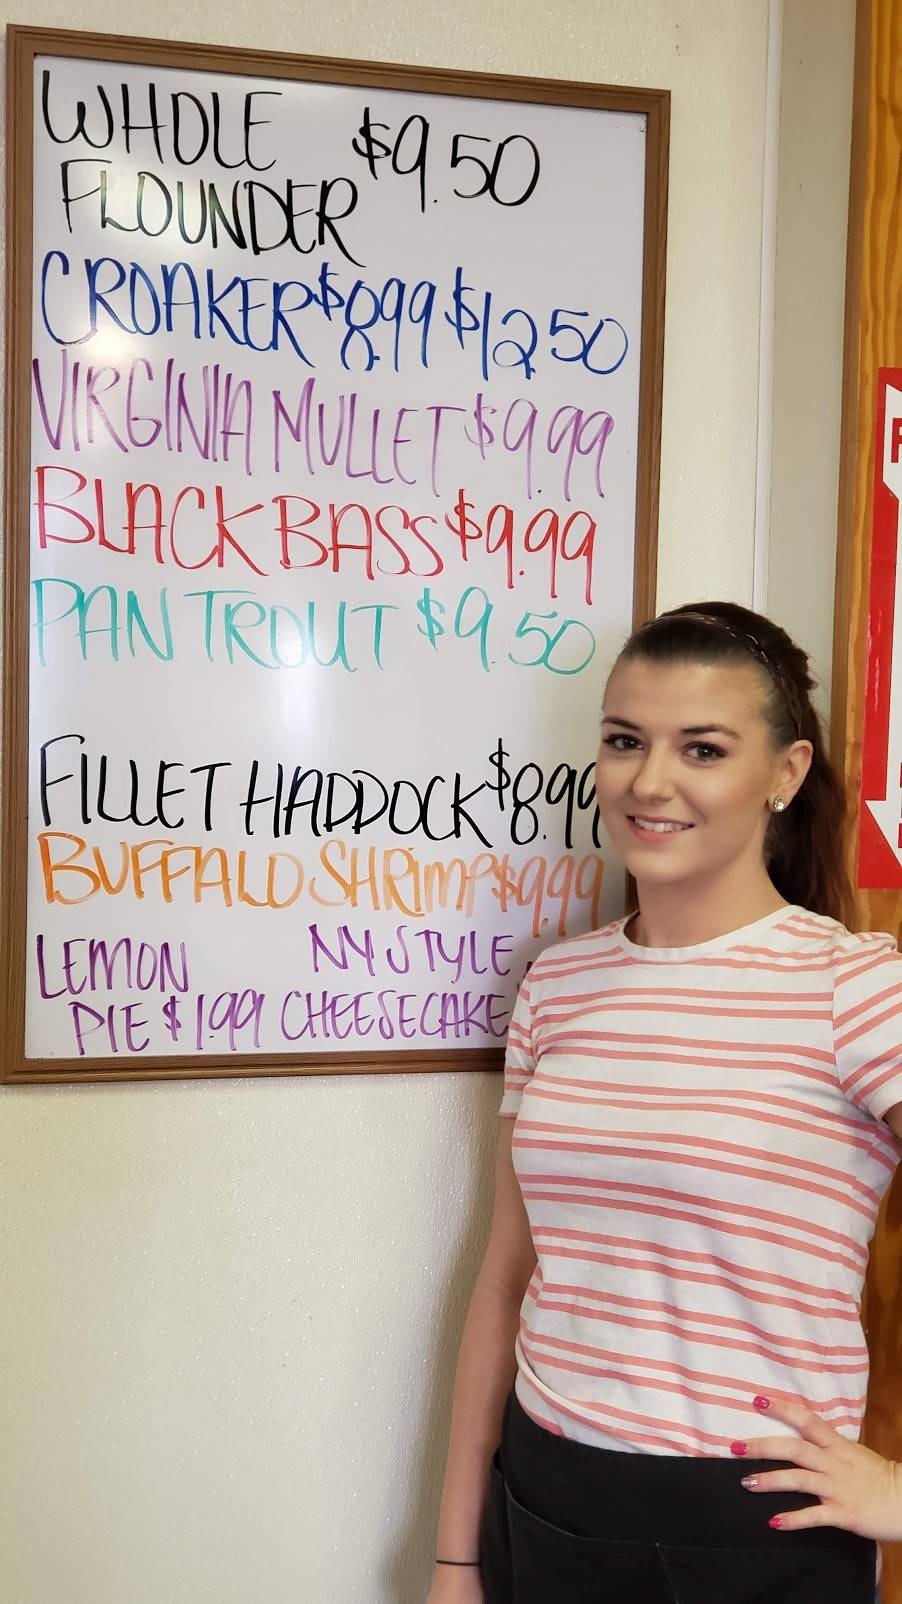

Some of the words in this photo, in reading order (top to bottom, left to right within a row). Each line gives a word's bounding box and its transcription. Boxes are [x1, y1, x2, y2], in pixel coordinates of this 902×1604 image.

[42, 69, 282, 171] WHOLE
[352, 107, 540, 212] $9.50
[61, 158, 366, 267] FLOUNDER
[40, 250, 316, 368] CROAKER
[32, 350, 253, 476] VIRGINIA
[274, 378, 465, 497] MULLET
[464, 393, 615, 499] $9.99
[33, 465, 270, 577] BLACK
[272, 495, 444, 580] BASS
[444, 489, 598, 606] $9.99
[31, 578, 175, 667] PAN
[183, 586, 400, 673] TROUT
[416, 586, 597, 675] $9.50
[39, 734, 230, 832] FILLET
[238, 760, 495, 849] HADDOCK
[40, 832, 304, 910] BUFFALO
[491, 853, 605, 939] $9.99
[310, 923, 377, 976] NY
[393, 928, 514, 984] STYLE
[69, 1001, 151, 1057] PIE
[162, 988, 267, 1051] $1.99
[281, 989, 510, 1042] CHEESECAKE
